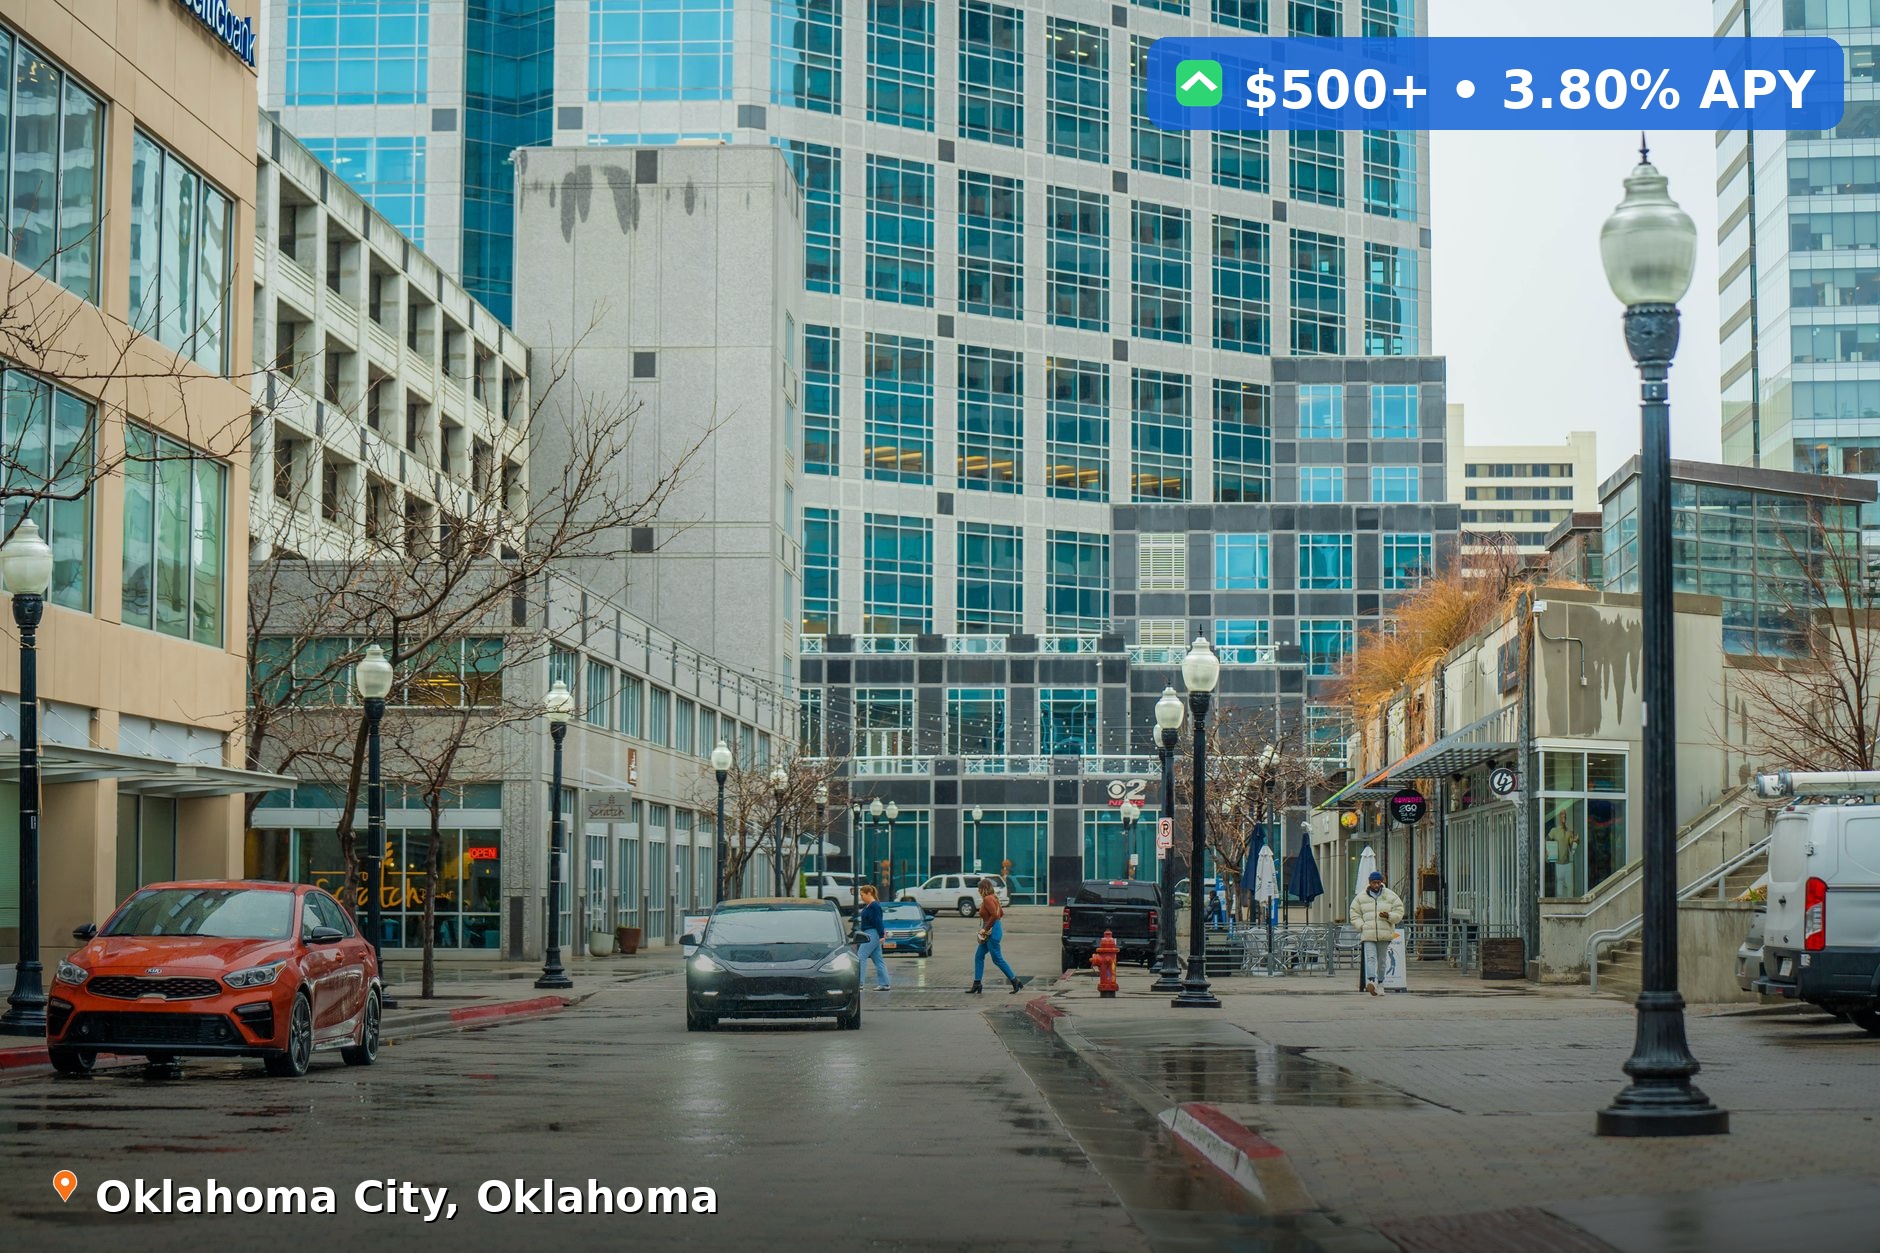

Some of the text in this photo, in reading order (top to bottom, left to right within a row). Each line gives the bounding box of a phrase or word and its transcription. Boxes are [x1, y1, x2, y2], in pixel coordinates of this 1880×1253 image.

[184, 0, 257, 67] ticbank
[1126, 779, 1148, 800] 2
[1108, 799, 1145, 807] NES
[471, 848, 496, 858] OPEN
